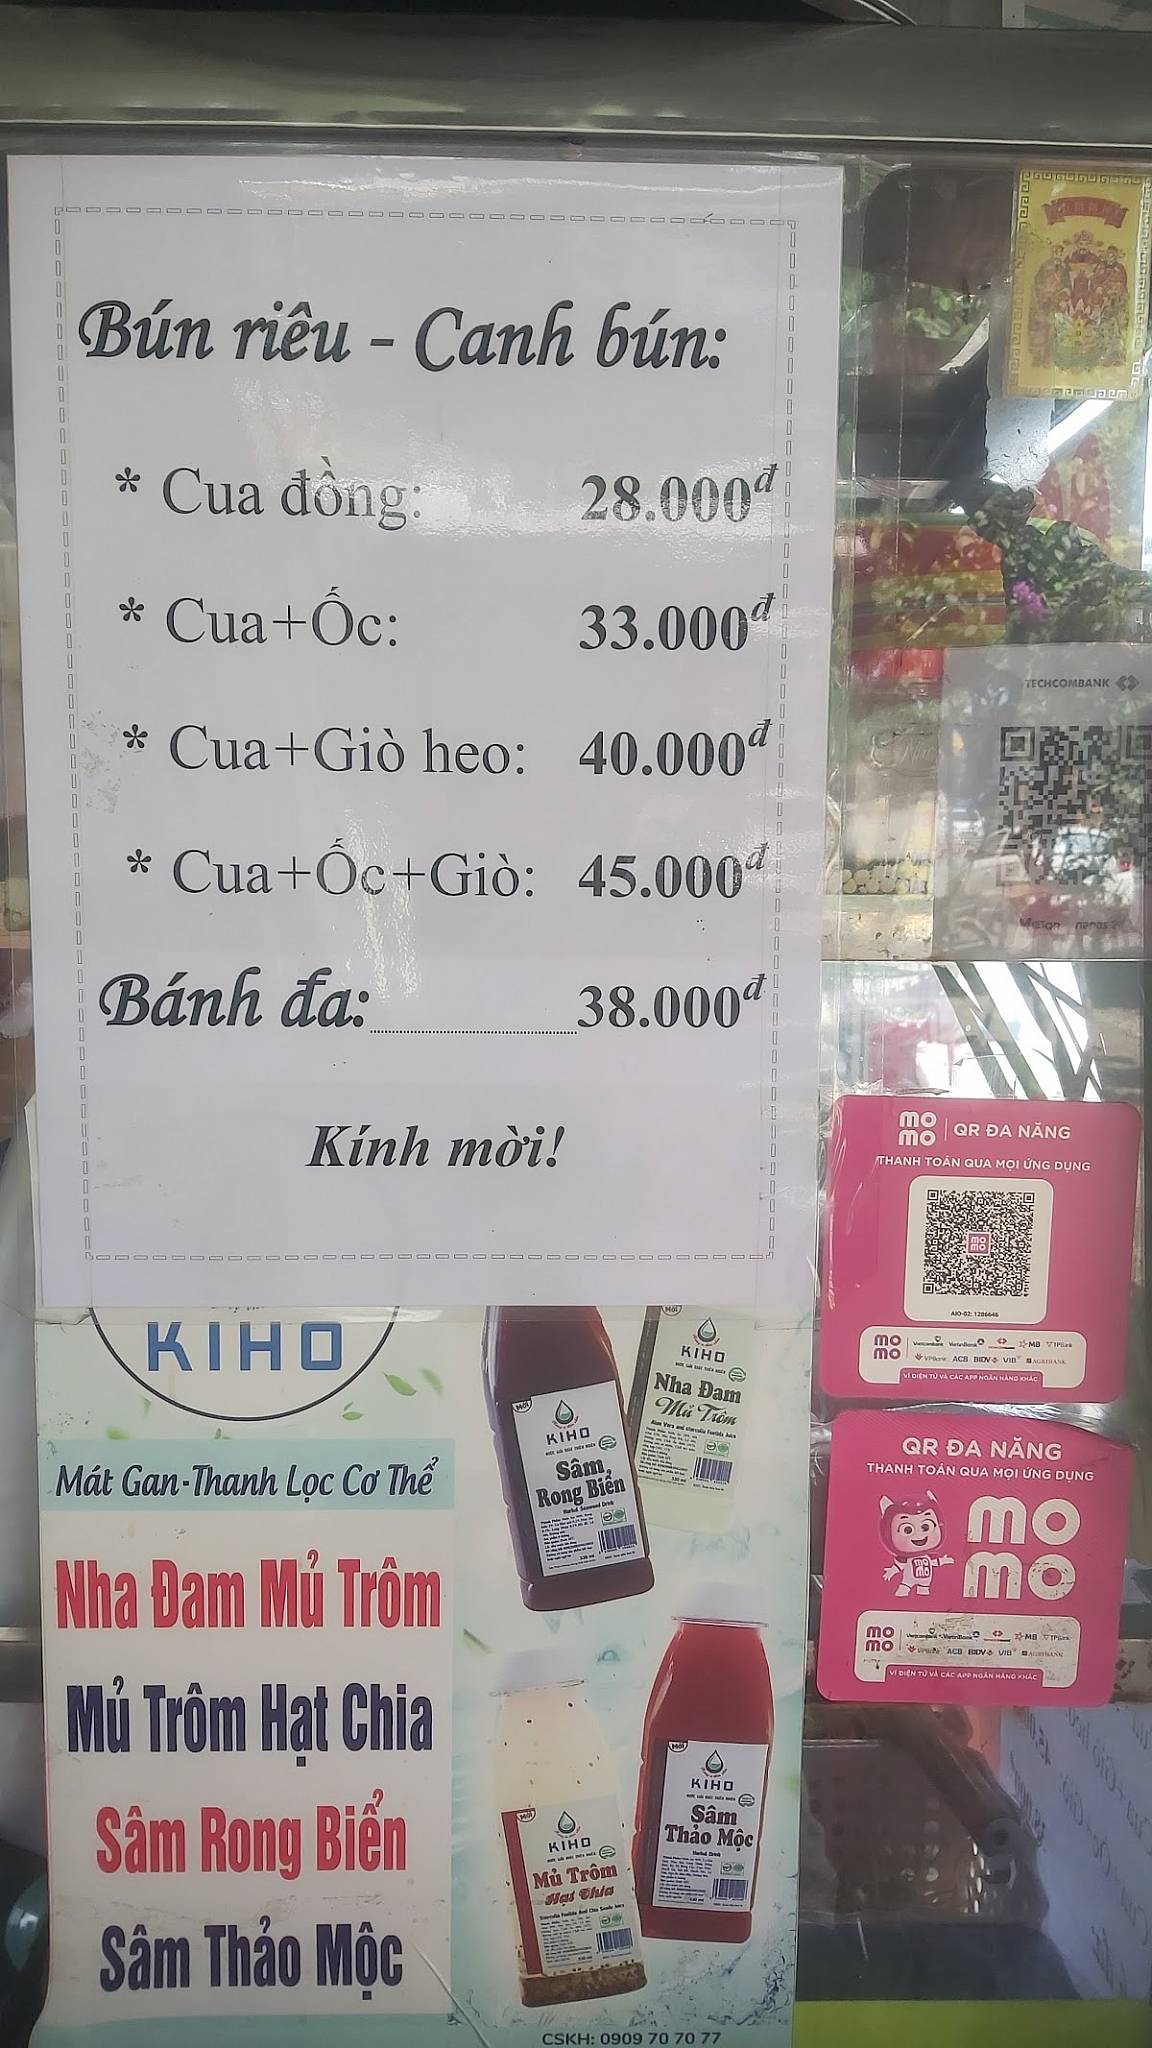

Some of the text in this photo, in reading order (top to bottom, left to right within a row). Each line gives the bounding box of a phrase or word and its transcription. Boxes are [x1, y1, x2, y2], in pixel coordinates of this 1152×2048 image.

[79, 299, 214, 360] Bún
[233, 302, 351, 362] riêu
[414, 300, 573, 371] Canh
[597, 303, 728, 369] bún:
[162, 456, 421, 531] Cua đồng:
[166, 587, 398, 647] Cua+Ốc:
[1025, 677, 1110, 690] TECHCOMBANK
[169, 726, 525, 774] Cua+Giò heo:
[173, 838, 535, 898] Cua+Ốc+Giò:
[99, 967, 261, 1028] Bánh
[281, 968, 370, 1028] đa:
[953, 1122, 1072, 1140] QR ĐA NĂNG
[306, 1126, 566, 1168] Kính mời!
[877, 1155, 1092, 1173] THANH TOÁN QUA MỌI ỨNG DỤNG
[147, 1321, 343, 1371] KIHO
[681, 1345, 726, 1363] KIHO
[654, 1372, 742, 1404] Nha Đam
[697, 1403, 738, 1426] Trôm
[546, 1427, 591, 1445] KIHO
[902, 1436, 1062, 1461] QR ĐA NĂNG
[56, 1465, 113, 1497] Mát
[287, 1465, 333, 1503] Lọc
[343, 1464, 380, 1496] Cơ
[388, 1457, 438, 1496] Thể
[556, 1457, 605, 1481] Sâm
[867, 1463, 1094, 1483] THANH TOÁN QUA MỌI ỨNG DỤNG
[536, 1484, 584, 1508] Rong
[586, 1469, 626, 1499] Biển
[56, 1549, 440, 1629] Nha Đam Mủ Trôm
[67, 1675, 433, 1767] Mủ Trôm Hạt Chia
[691, 1778, 734, 1791] KIHO
[691, 1804, 737, 1826] Sâm
[97, 1789, 406, 1880] Sâm Rong Biển
[548, 1837, 591, 1853] KIHO
[665, 1823, 753, 1851] Thảo Mộc
[533, 1863, 617, 1890] Mủ Trôm
[100, 1916, 403, 2001] Sâm Thảo Mộc
[542, 2032, 722, 2046] CSKH: 0909 70 70 77
